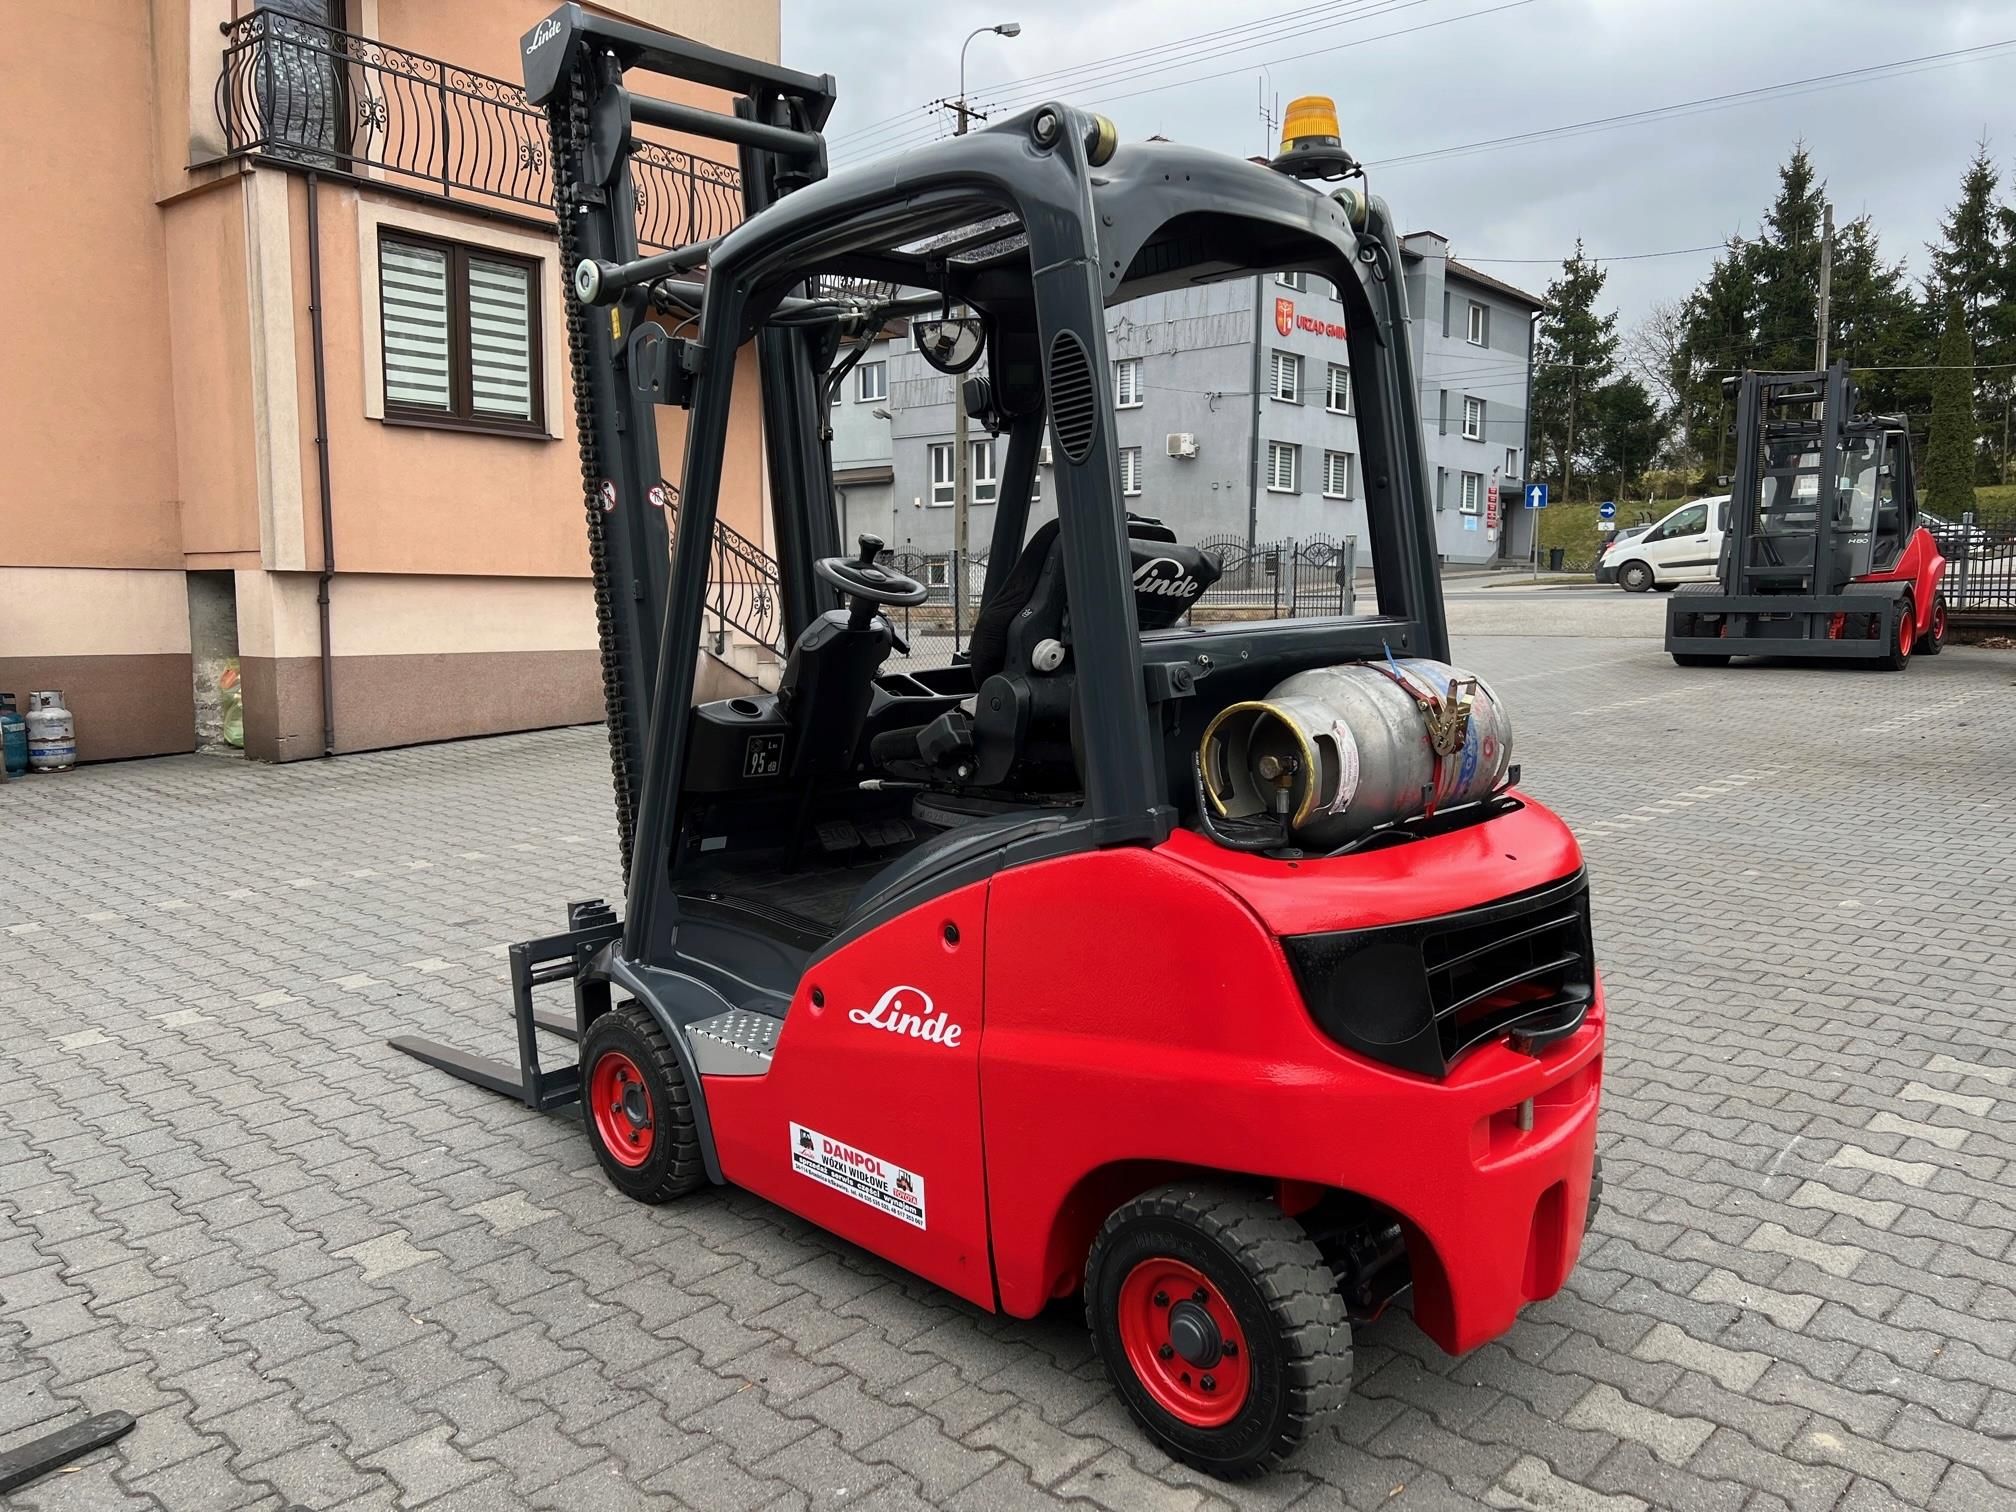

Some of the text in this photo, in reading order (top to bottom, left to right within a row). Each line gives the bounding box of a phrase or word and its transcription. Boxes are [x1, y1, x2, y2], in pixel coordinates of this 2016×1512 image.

[526, 18, 562, 55] Linde
[1296, 315, 1325, 336] URZĄD
[1132, 557, 1199, 598] Linde
[751, 751, 766, 774] 95
[848, 984, 962, 1048] Linde
[821, 1154, 889, 1192] WÓZKI WIDŁOWE
[822, 1139, 886, 1178] DANPOL
[831, 1170, 854, 1187] serwis
[883, 1193, 917, 1215] wynajem
[893, 1188, 918, 1205] TOYOTA
